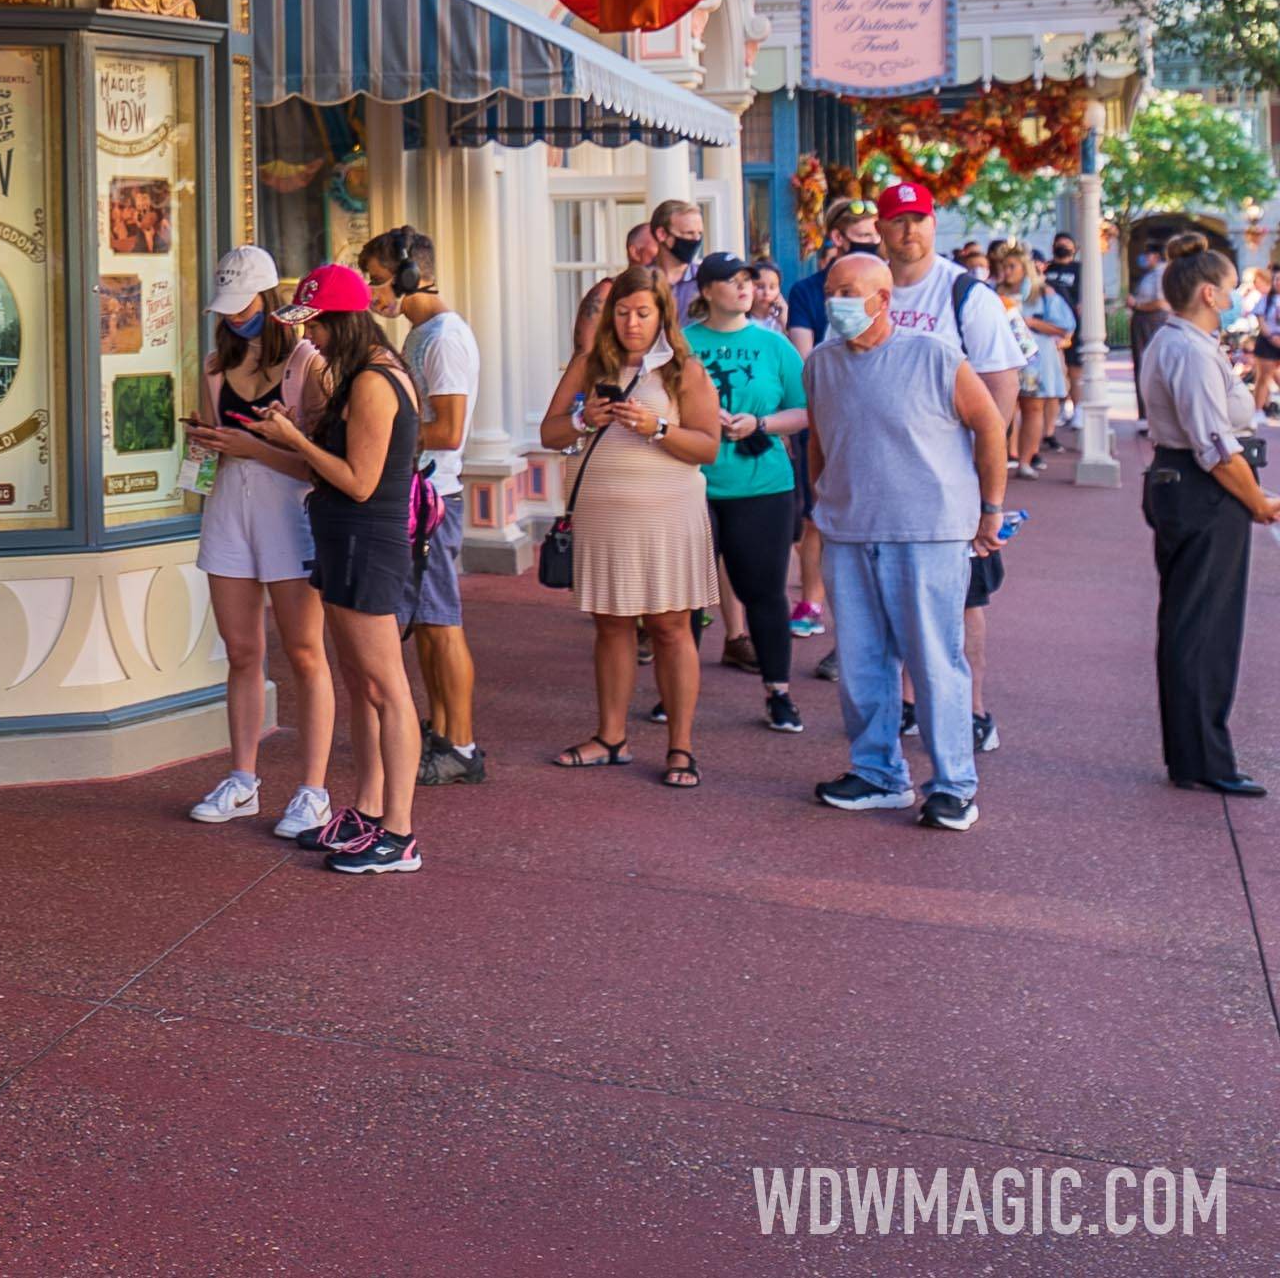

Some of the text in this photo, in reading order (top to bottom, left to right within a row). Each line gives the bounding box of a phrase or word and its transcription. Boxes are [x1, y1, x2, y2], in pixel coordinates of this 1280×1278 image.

[104, 99, 146, 136] WDW
[716, 347, 732, 360] SO
[737, 348, 761, 361] FLY
